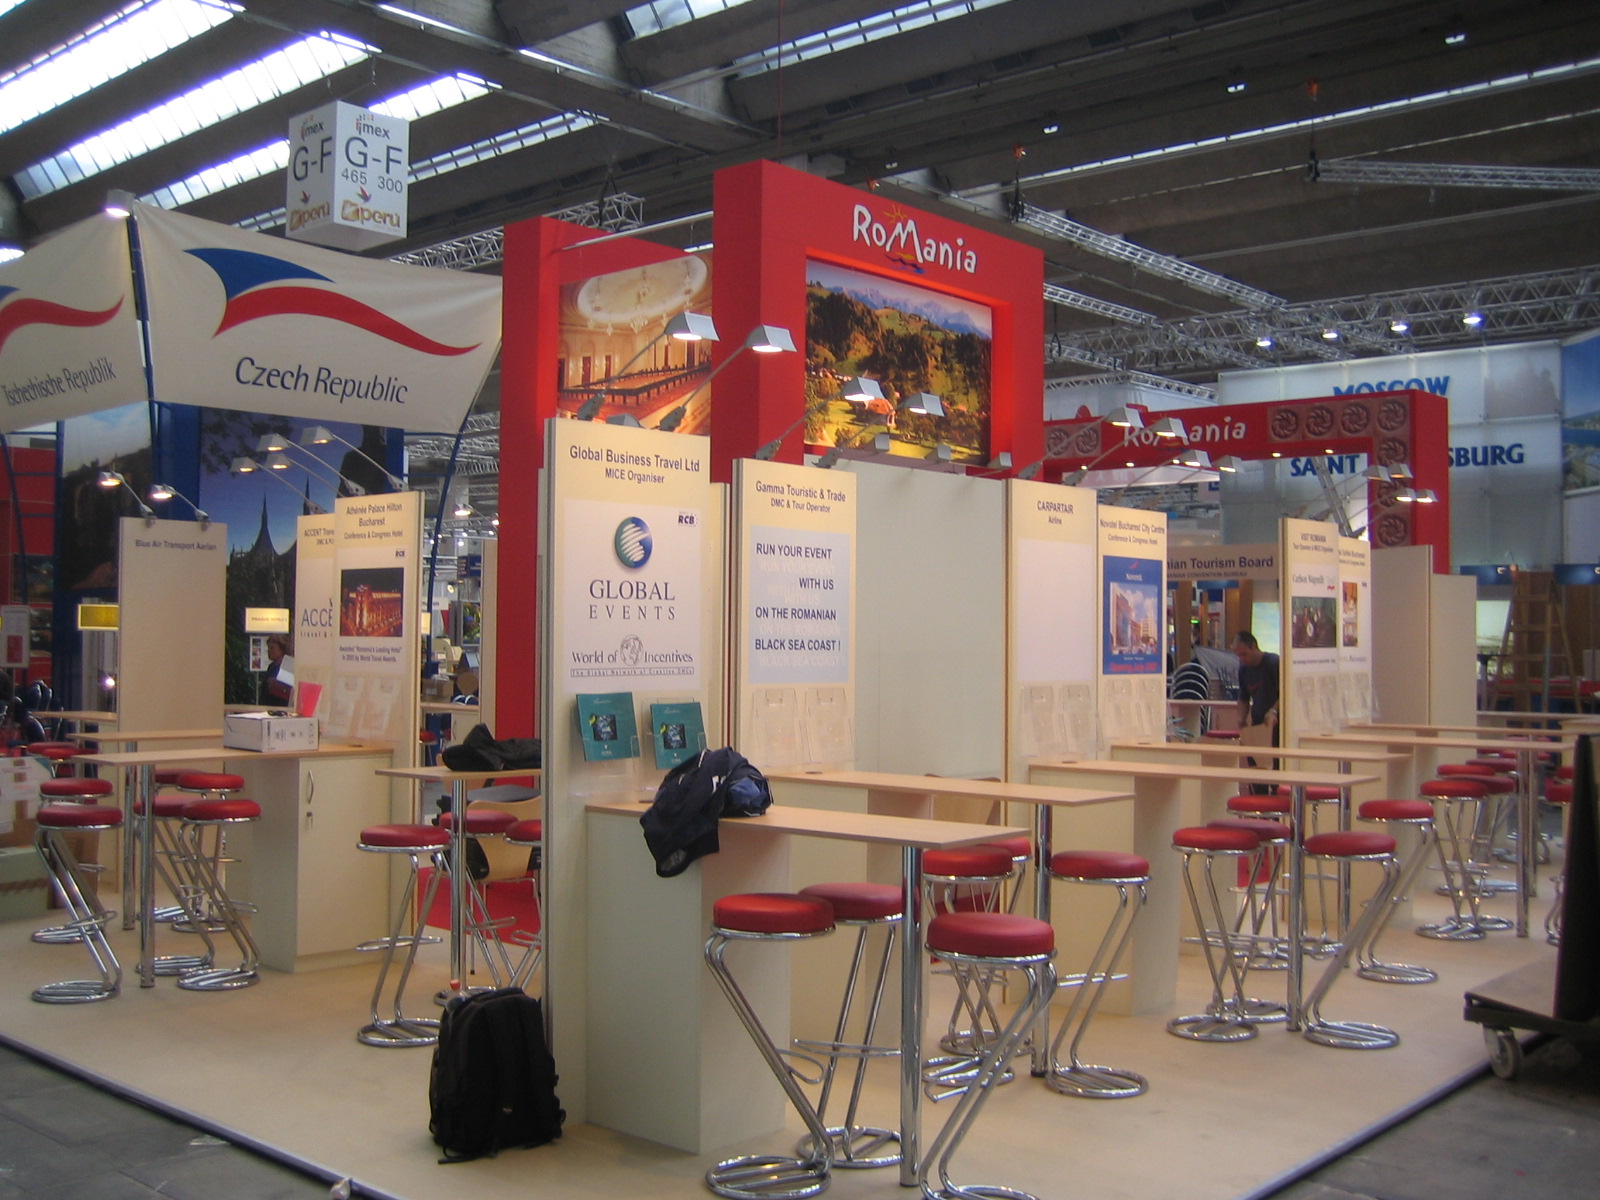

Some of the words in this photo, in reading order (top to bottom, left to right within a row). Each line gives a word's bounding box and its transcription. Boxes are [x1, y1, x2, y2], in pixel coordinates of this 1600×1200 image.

[293, 136, 333, 181] G-F
[345, 136, 402, 174] G-F
[341, 167, 368, 185] 465
[377, 175, 403, 193] 300
[2, 373, 66, 407] Tschechische
[62, 357, 117, 393] Republik
[235, 356, 310, 392] Czech
[313, 366, 408, 404] Republic
[569, 445, 603, 462] Global
[606, 449, 651, 467] Business
[654, 454, 682, 470] Travel
[685, 458, 700, 472] Ltd
[1290, 454, 1360, 477] SANT
[605, 467, 625, 480] MICE
[628, 470, 665, 484] Organiser
[756, 480, 785, 495] Gamma
[787, 484, 817, 499] Touristic
[819, 488, 825, 500] &
[827, 489, 846, 502] Trade
[793, 500, 805, 510] Tour
[806, 502, 830, 513] Operator
[678, 515, 695, 524] RCB
[756, 543, 775, 556] RUN
[778, 544, 803, 558] YOUR
[805, 547, 832, 560] EVENT
[1190, 557, 1235, 569] Tourism
[1239, 556, 1273, 568] Board
[589, 579, 675, 601] GLOBAL
[799, 577, 820, 590] WITH
[822, 579, 834, 590] US
[589, 604, 675, 621] EVENTS
[755, 606, 769, 619] ON
[771, 607, 788, 619] THE
[790, 608, 836, 620] ROMANIAN
[755, 638, 786, 650] BLACK
[788, 639, 805, 651] SEA
[807, 639, 836, 651] COAST
[572, 650, 604, 664] World
[607, 650, 619, 663] of
[644, 649, 693, 663] Incentives
